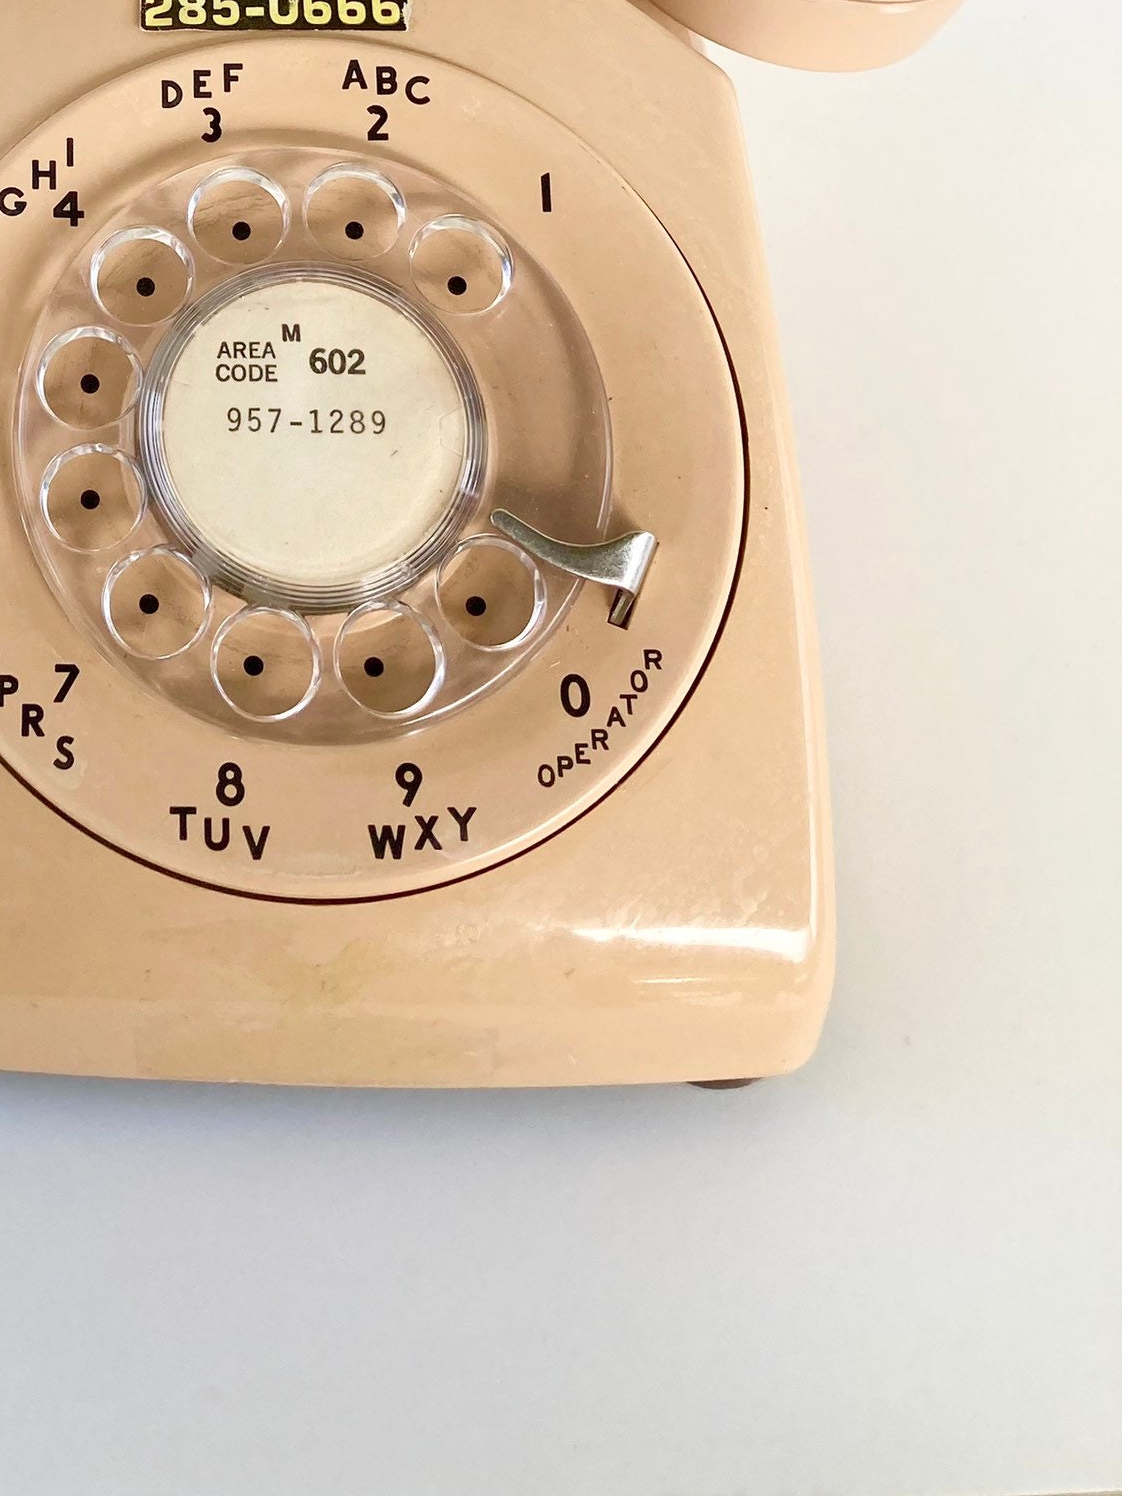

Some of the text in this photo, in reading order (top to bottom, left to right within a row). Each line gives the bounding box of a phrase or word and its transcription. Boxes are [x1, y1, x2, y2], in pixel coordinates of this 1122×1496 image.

[161, 63, 244, 109] DEF
[341, 59, 431, 105] ABC
[200, 109, 223, 144] 3
[366, 105, 389, 142] 2
[52, 190, 85, 228] 4
[216, 341, 277, 360] AREA
[281, 323, 301, 343] M
[215, 364, 278, 383] CODE
[309, 347, 366, 375] 602
[227, 407, 386, 435] 957-1289
[53, 663, 80, 703] 7
[537, 648, 663, 788] OPERATOR
[215, 762, 246, 807] 8
[395, 762, 423, 808] 9
[169, 806, 271, 861] TUV
[367, 806, 478, 860] WXY
